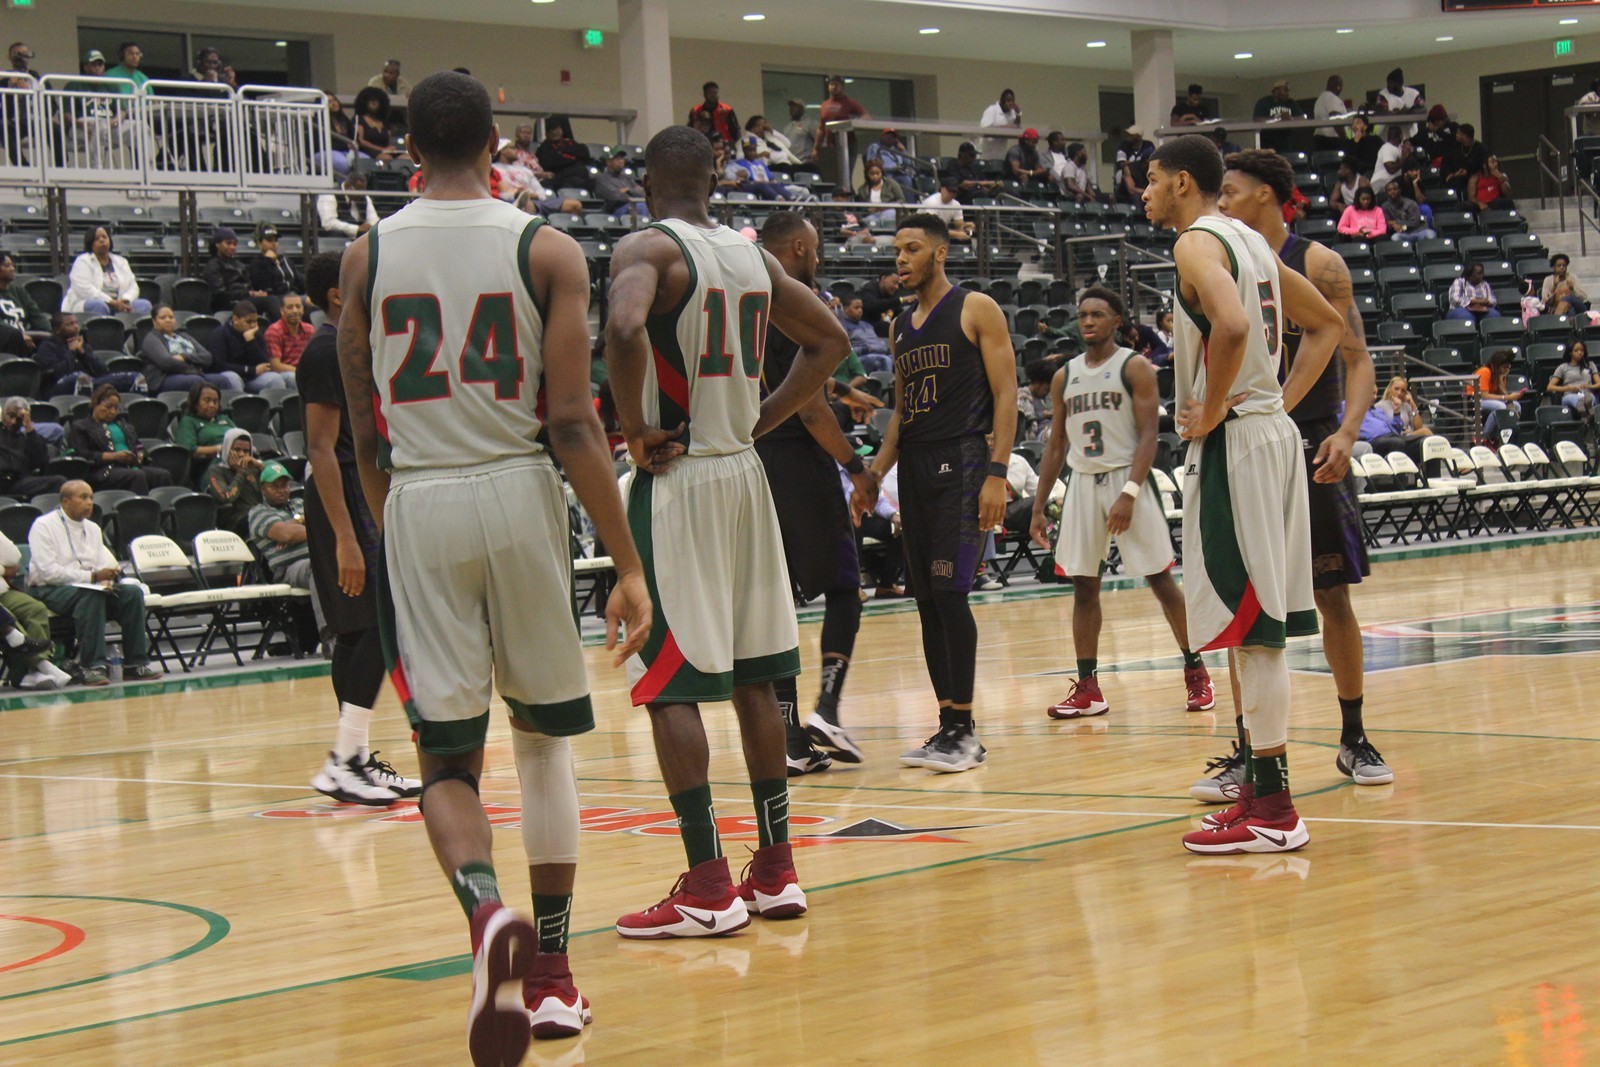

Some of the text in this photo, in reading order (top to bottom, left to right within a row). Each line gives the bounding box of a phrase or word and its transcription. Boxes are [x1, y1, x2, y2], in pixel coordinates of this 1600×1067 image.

[1556, 40, 1571, 55] EXIT
[381, 291, 525, 405] 24
[698, 287, 769, 379] 10
[896, 344, 951, 378] VAMU
[902, 374, 938, 424] 14
[1083, 420, 1104, 457] 3
